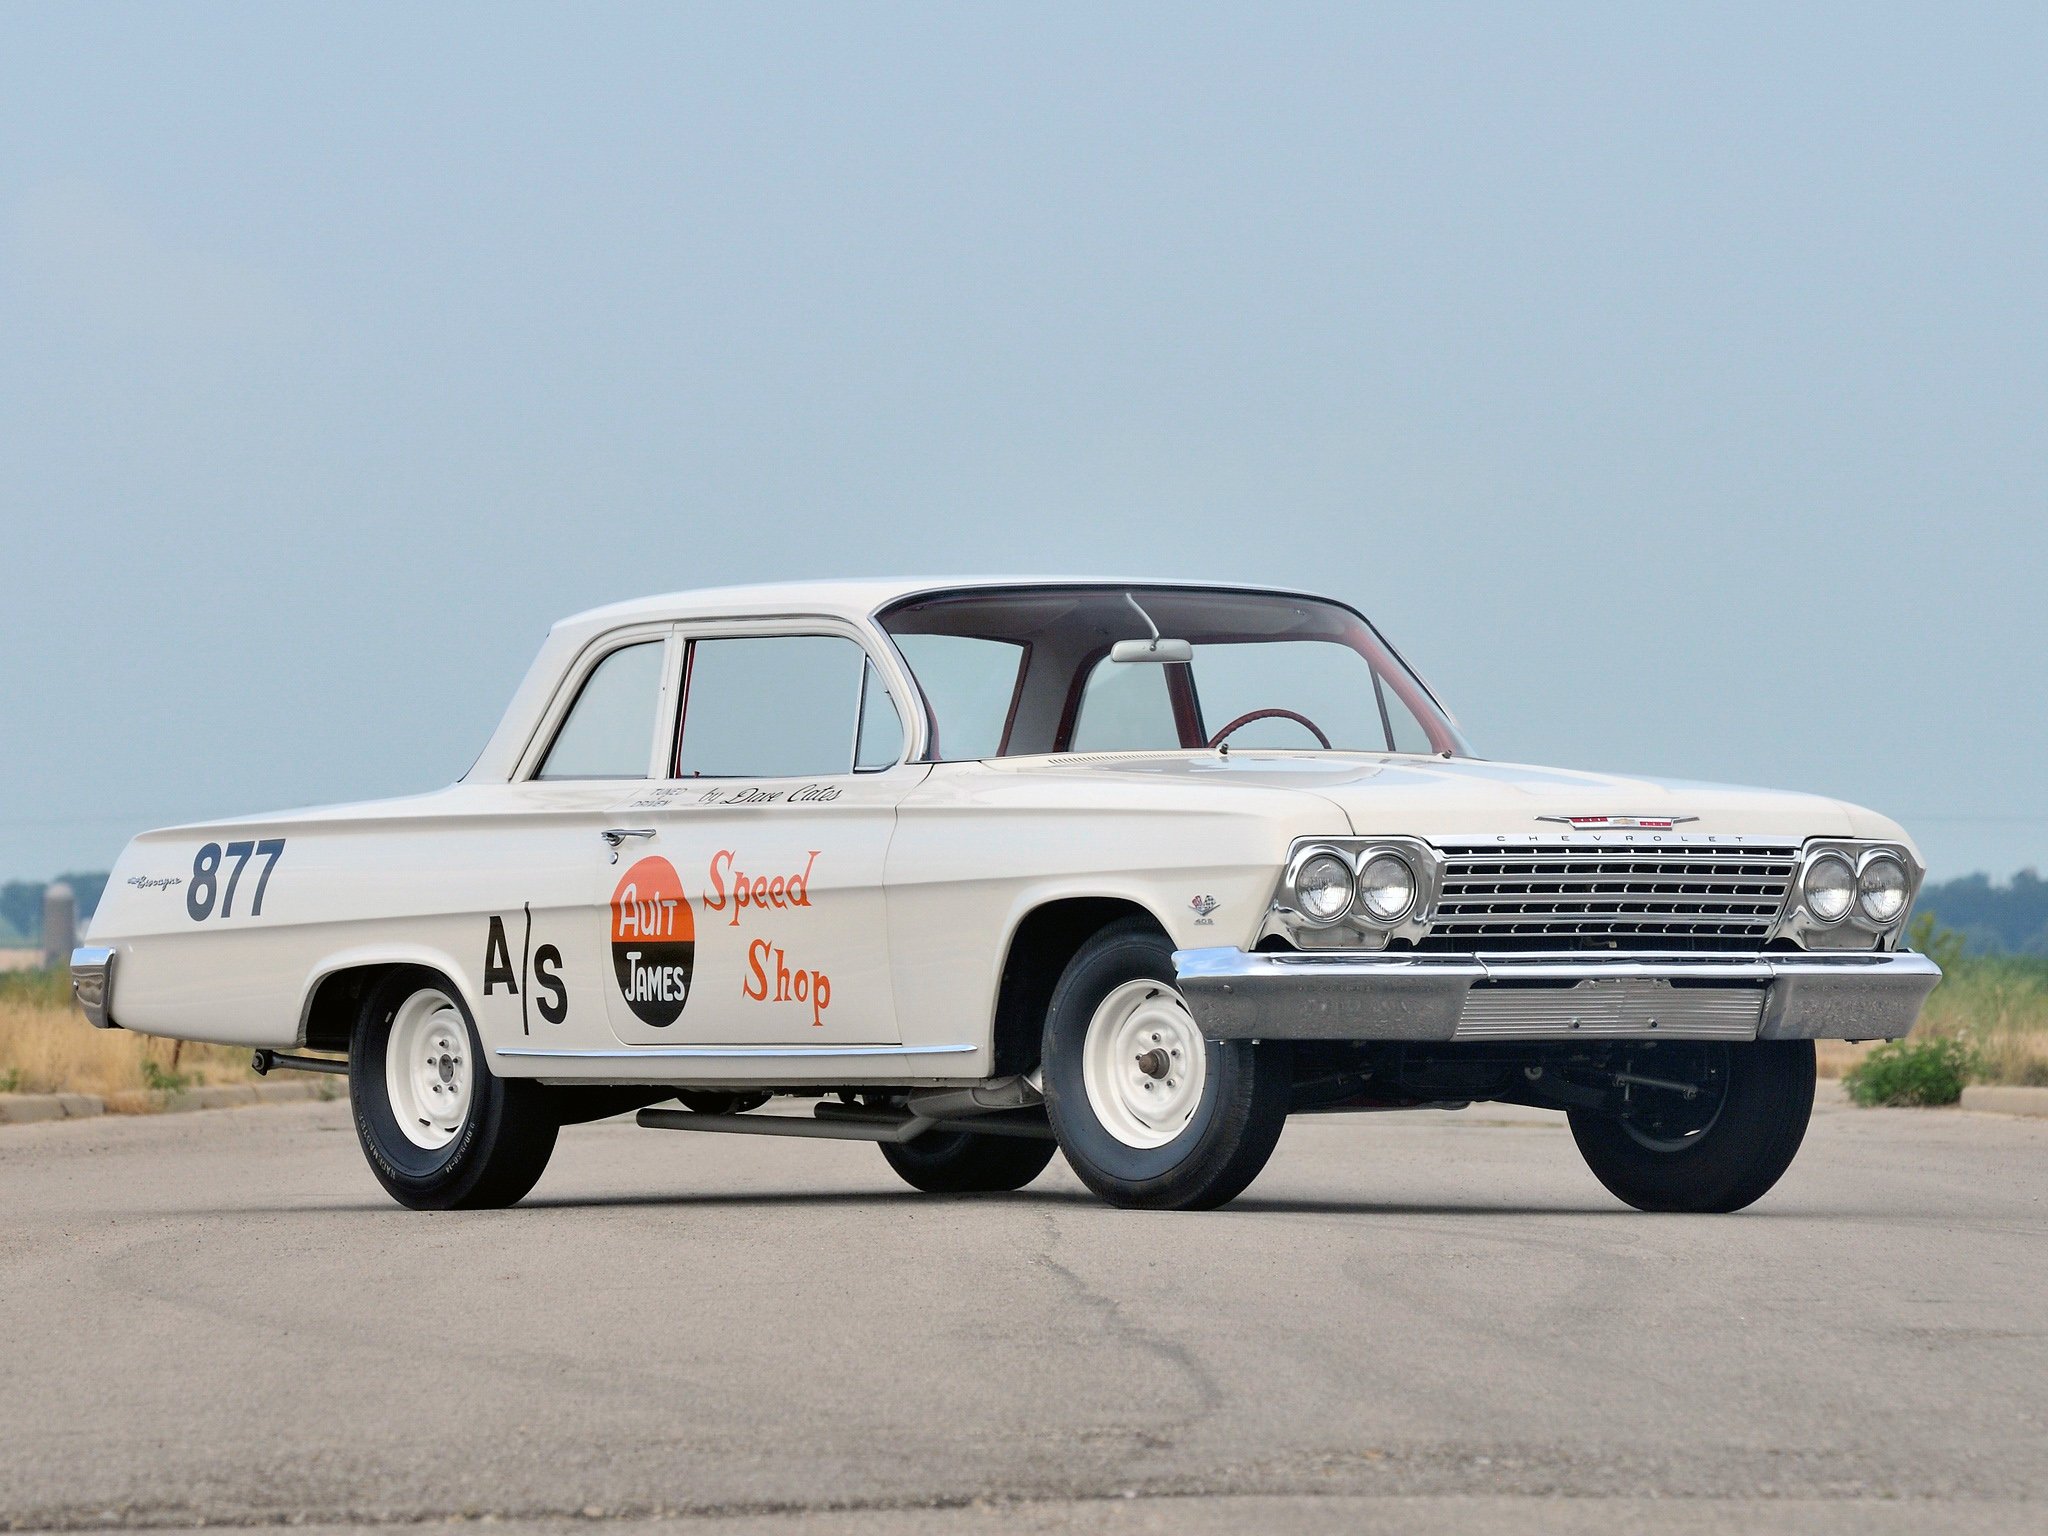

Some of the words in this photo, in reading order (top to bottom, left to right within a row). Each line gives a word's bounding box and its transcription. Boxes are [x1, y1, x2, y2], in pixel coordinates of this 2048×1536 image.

[698, 787, 724, 806] by
[719, 787, 784, 805] Dave
[787, 783, 843, 803] Cates
[187, 838, 286, 922] 877
[703, 849, 822, 926] Speed
[484, 901, 568, 1036] A/S
[743, 938, 831, 1027] Shop
